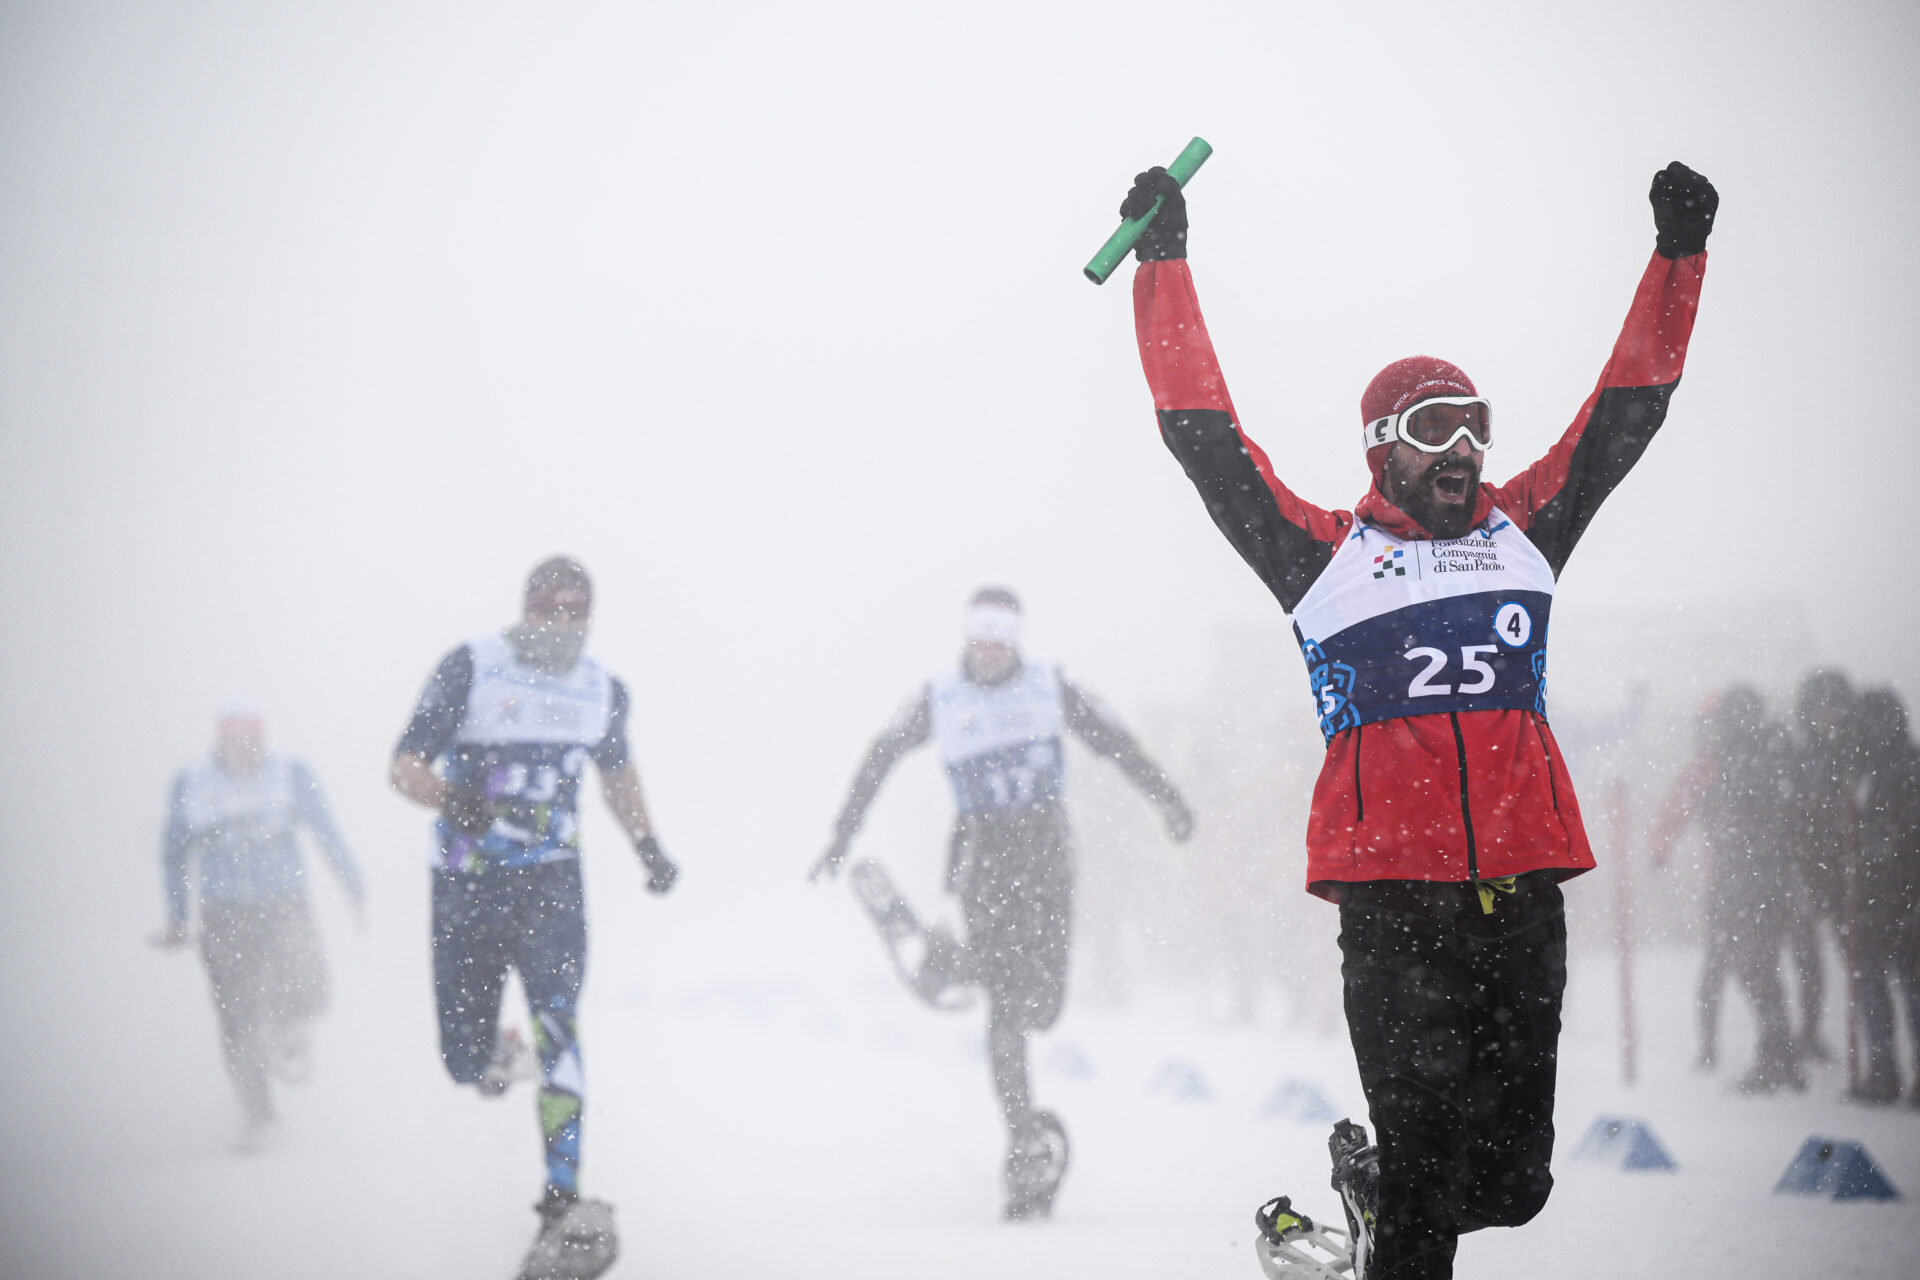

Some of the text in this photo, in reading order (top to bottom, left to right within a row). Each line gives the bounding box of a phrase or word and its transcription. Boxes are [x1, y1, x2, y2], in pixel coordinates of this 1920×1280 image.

[1416, 379, 1445, 390] OLYMPICS
[1431, 536, 1497, 549] Fondazione
[1432, 547, 1497, 560] Compagnia
[1433, 560, 1447, 573] di
[1506, 612, 1521, 638] 4
[1403, 644, 1499, 698] 25
